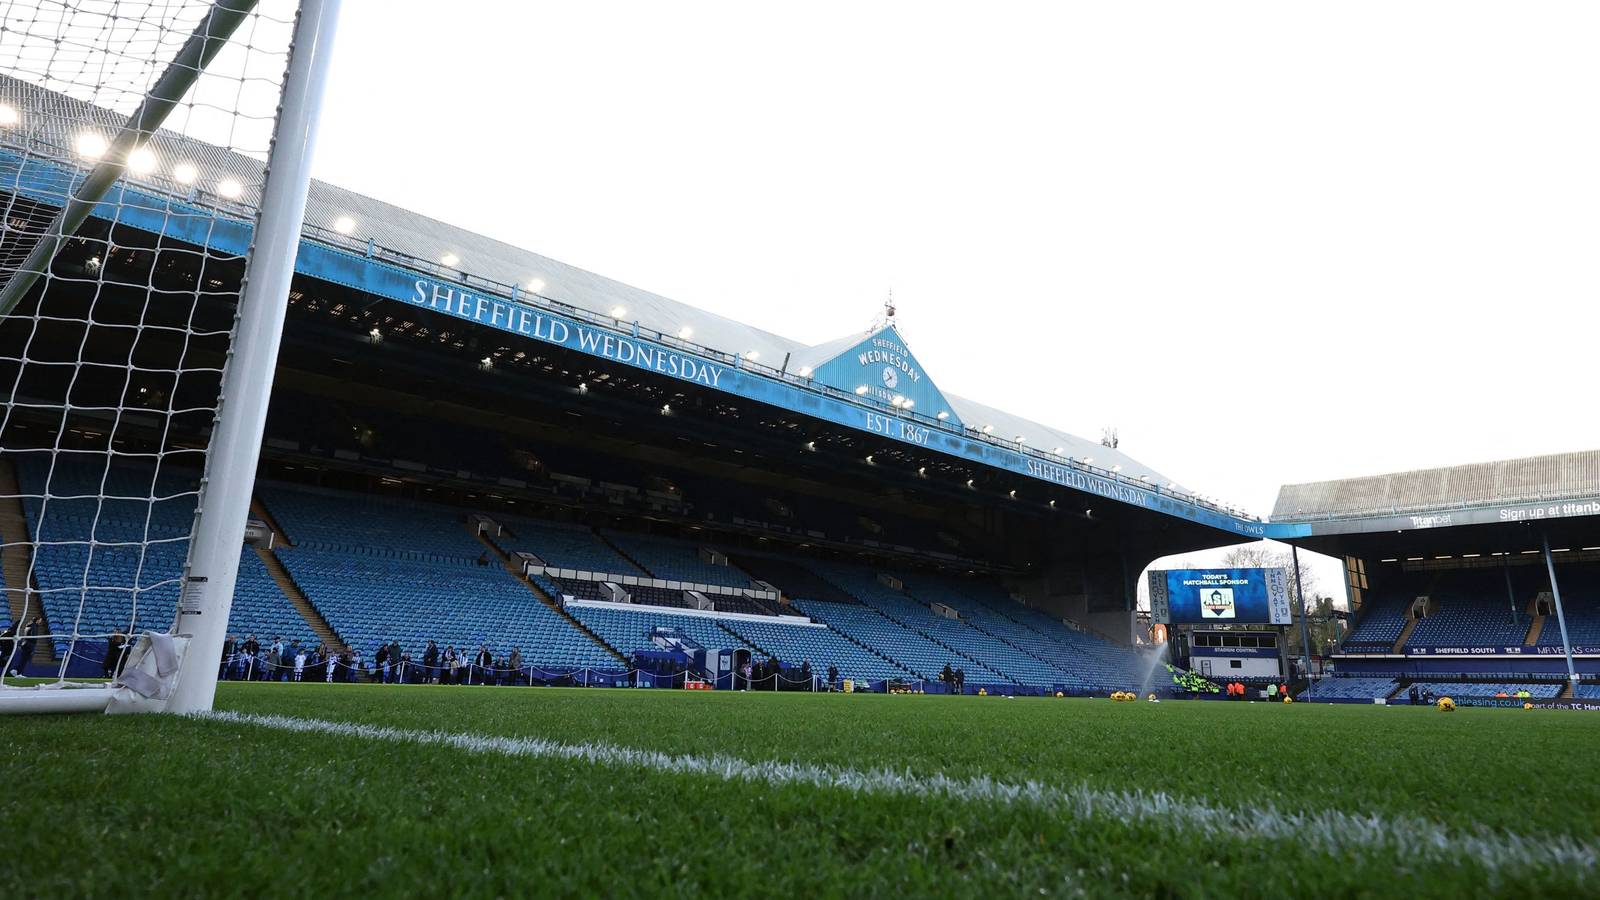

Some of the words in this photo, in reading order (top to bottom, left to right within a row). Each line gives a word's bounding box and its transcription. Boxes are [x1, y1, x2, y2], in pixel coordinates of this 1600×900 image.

[412, 280, 568, 344] SHEFFIELD
[577, 327, 723, 387] WEDNESDAY
[872, 338, 909, 358] SHEFFIELD
[858, 350, 921, 384] WEDNESDAY
[866, 412, 895, 437] EST.
[899, 422, 930, 446] 1867
[1027, 459, 1085, 489] SHEFFIELD
[1088, 478, 1147, 507] WEDNESDAY
[1244, 525, 1264, 535] OWLS
[1499, 508, 1525, 523] Sign
[1528, 507, 1544, 521] up
[1548, 504, 1560, 516] at
[1205, 593, 1230, 605] ASH
[1270, 569, 1281, 623] INNOVATION
[1276, 570, 1285, 605] ALLOYS
[1552, 646, 1583, 655] VEAS
